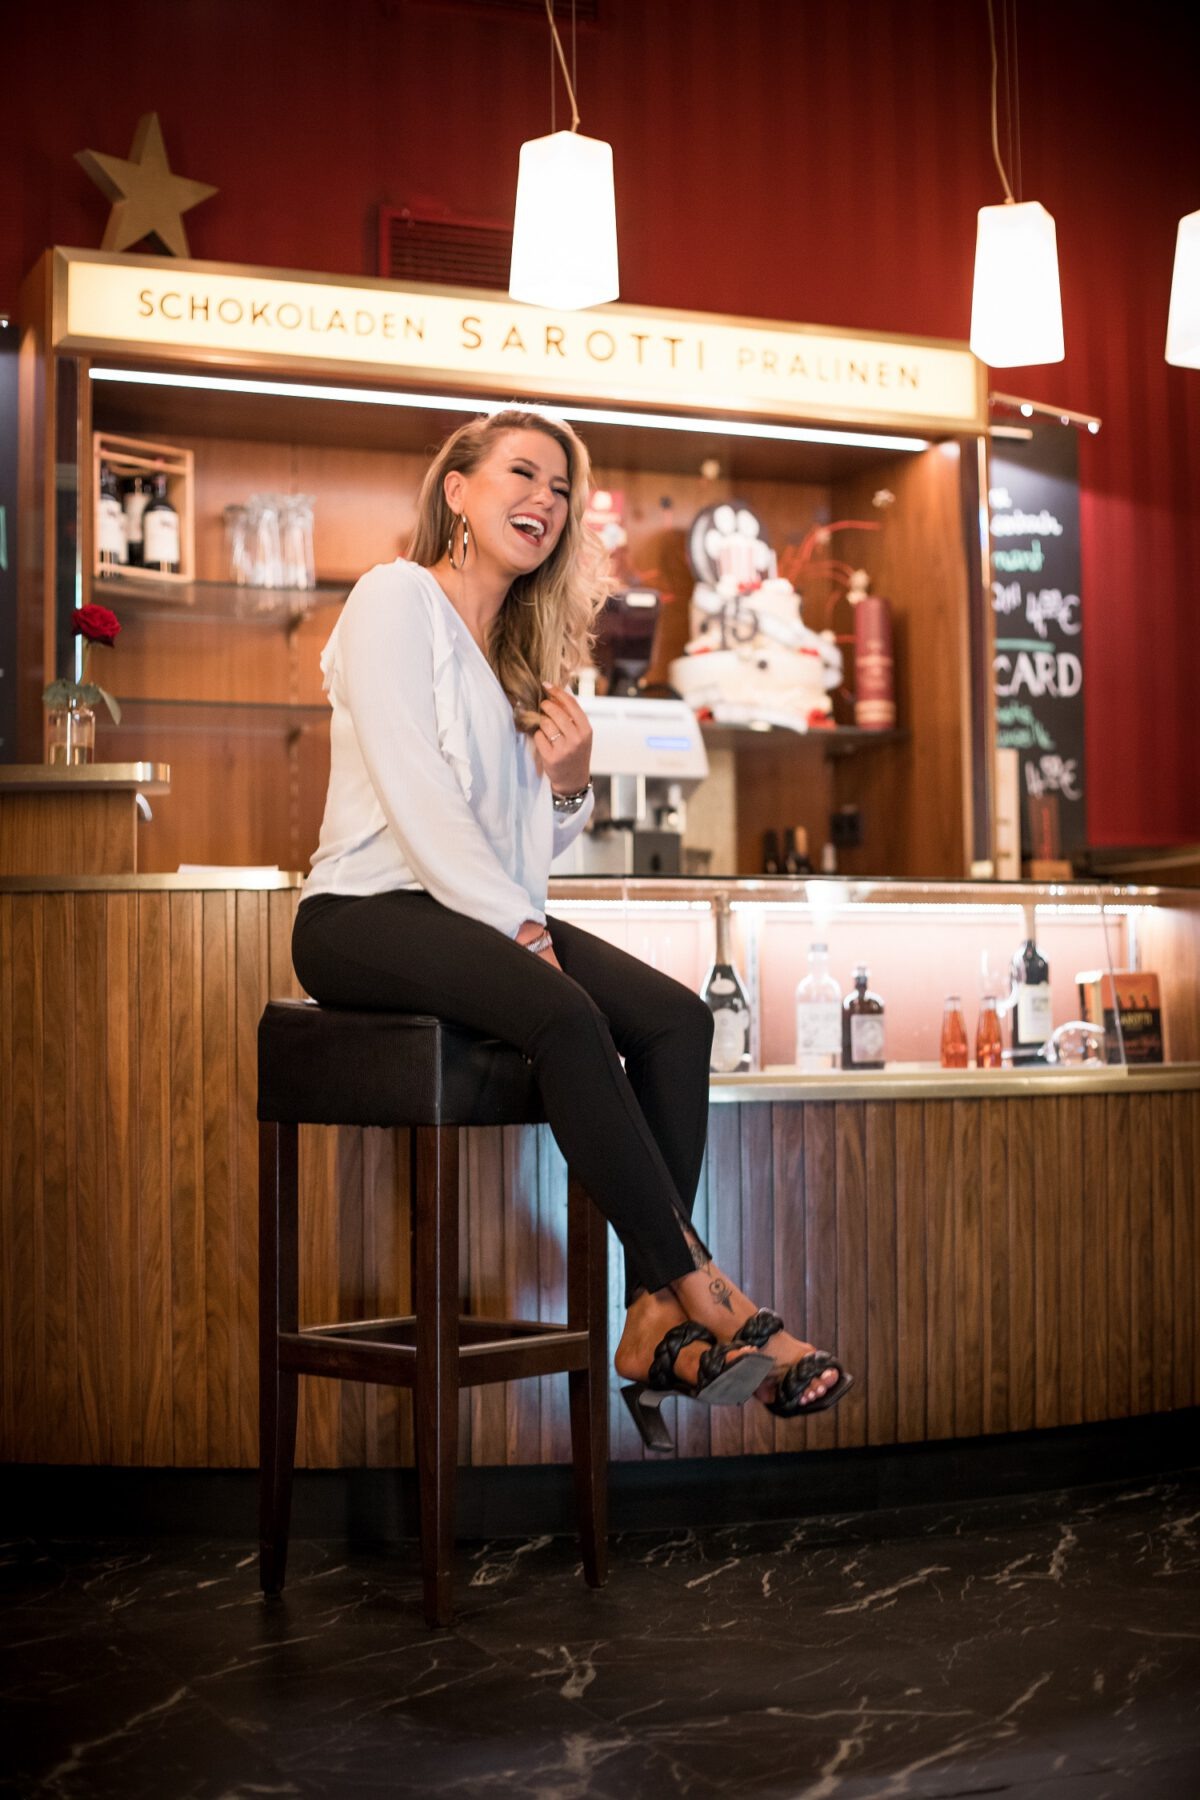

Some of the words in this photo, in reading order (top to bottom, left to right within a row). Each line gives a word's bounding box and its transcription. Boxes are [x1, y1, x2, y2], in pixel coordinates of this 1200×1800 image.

[137, 288, 425, 342] SCHOKOLADEN
[459, 314, 705, 372] SAROTTI
[736, 347, 920, 390] PRALINEN
